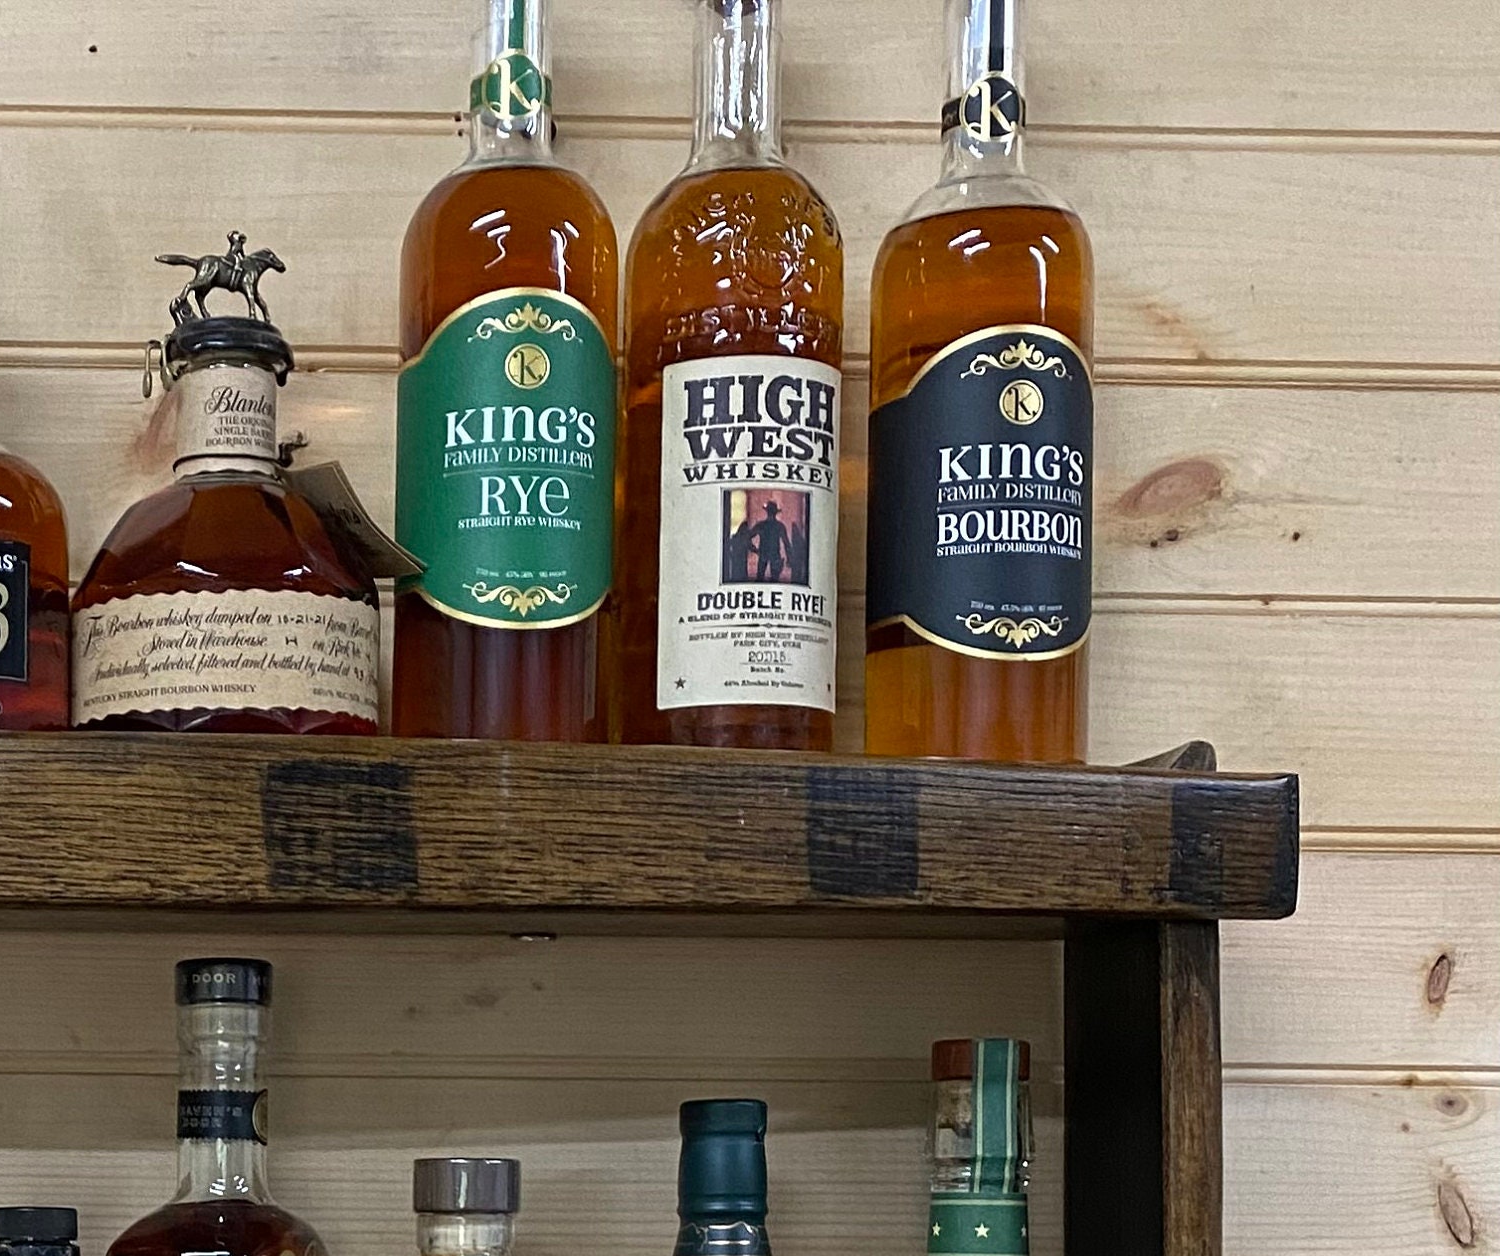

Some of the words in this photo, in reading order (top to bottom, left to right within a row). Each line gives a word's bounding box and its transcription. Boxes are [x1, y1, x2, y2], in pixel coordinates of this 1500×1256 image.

[683, 375, 835, 434] HIGH
[683, 426, 834, 467] WEST
[682, 463, 833, 488] WHISKEY
[697, 591, 784, 611] DOUBLE
[687, 613, 721, 623] BLEND
[723, 612, 736, 620] OF
[739, 612, 786, 621] STRAIGHT
[788, 613, 804, 622] RYE
[160, 684, 209, 696] BOURBON
[211, 683, 257, 693] WHISKEY
[192, 973, 237, 984] DOOR
